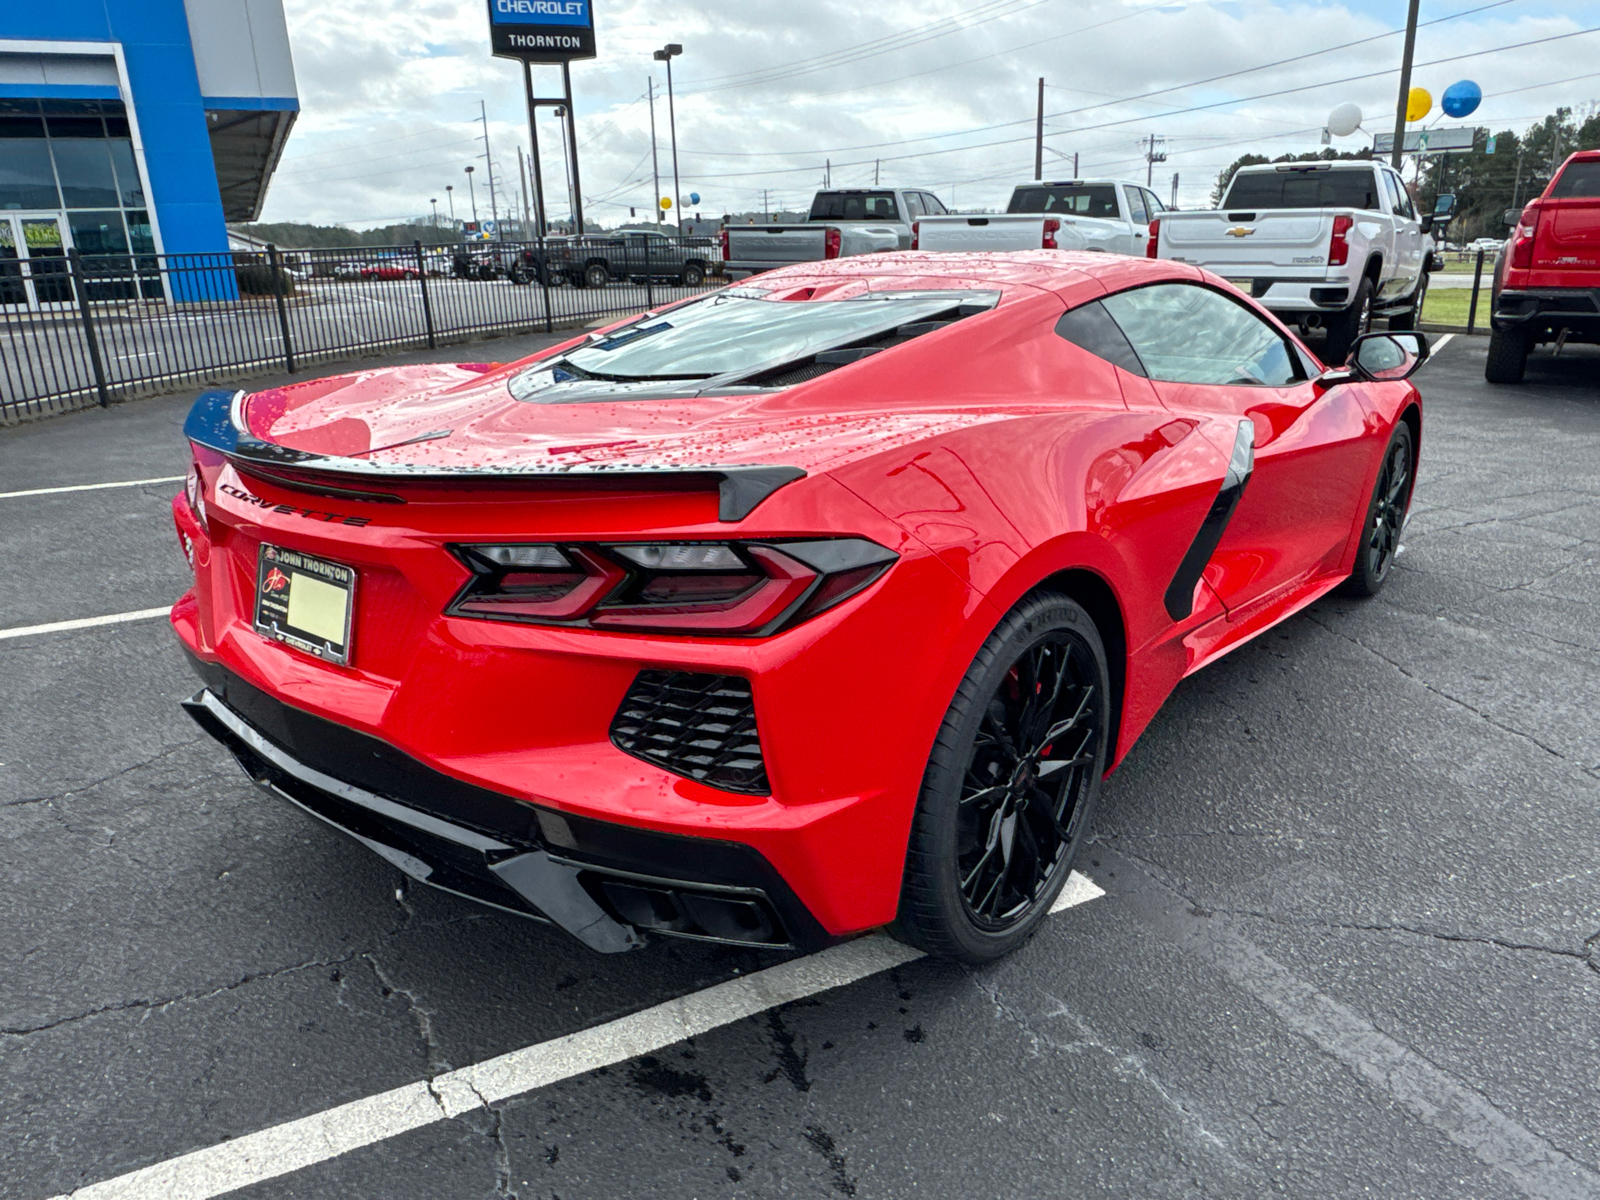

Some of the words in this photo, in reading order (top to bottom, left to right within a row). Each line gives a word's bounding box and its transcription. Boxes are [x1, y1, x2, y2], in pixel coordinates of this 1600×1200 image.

[497, 0, 583, 15] CHEVROLET
[508, 34, 580, 48] THORNTON
[219, 484, 372, 527] CORVETTE
[280, 551, 302, 567] JOHN
[303, 558, 348, 582] THORNTON
